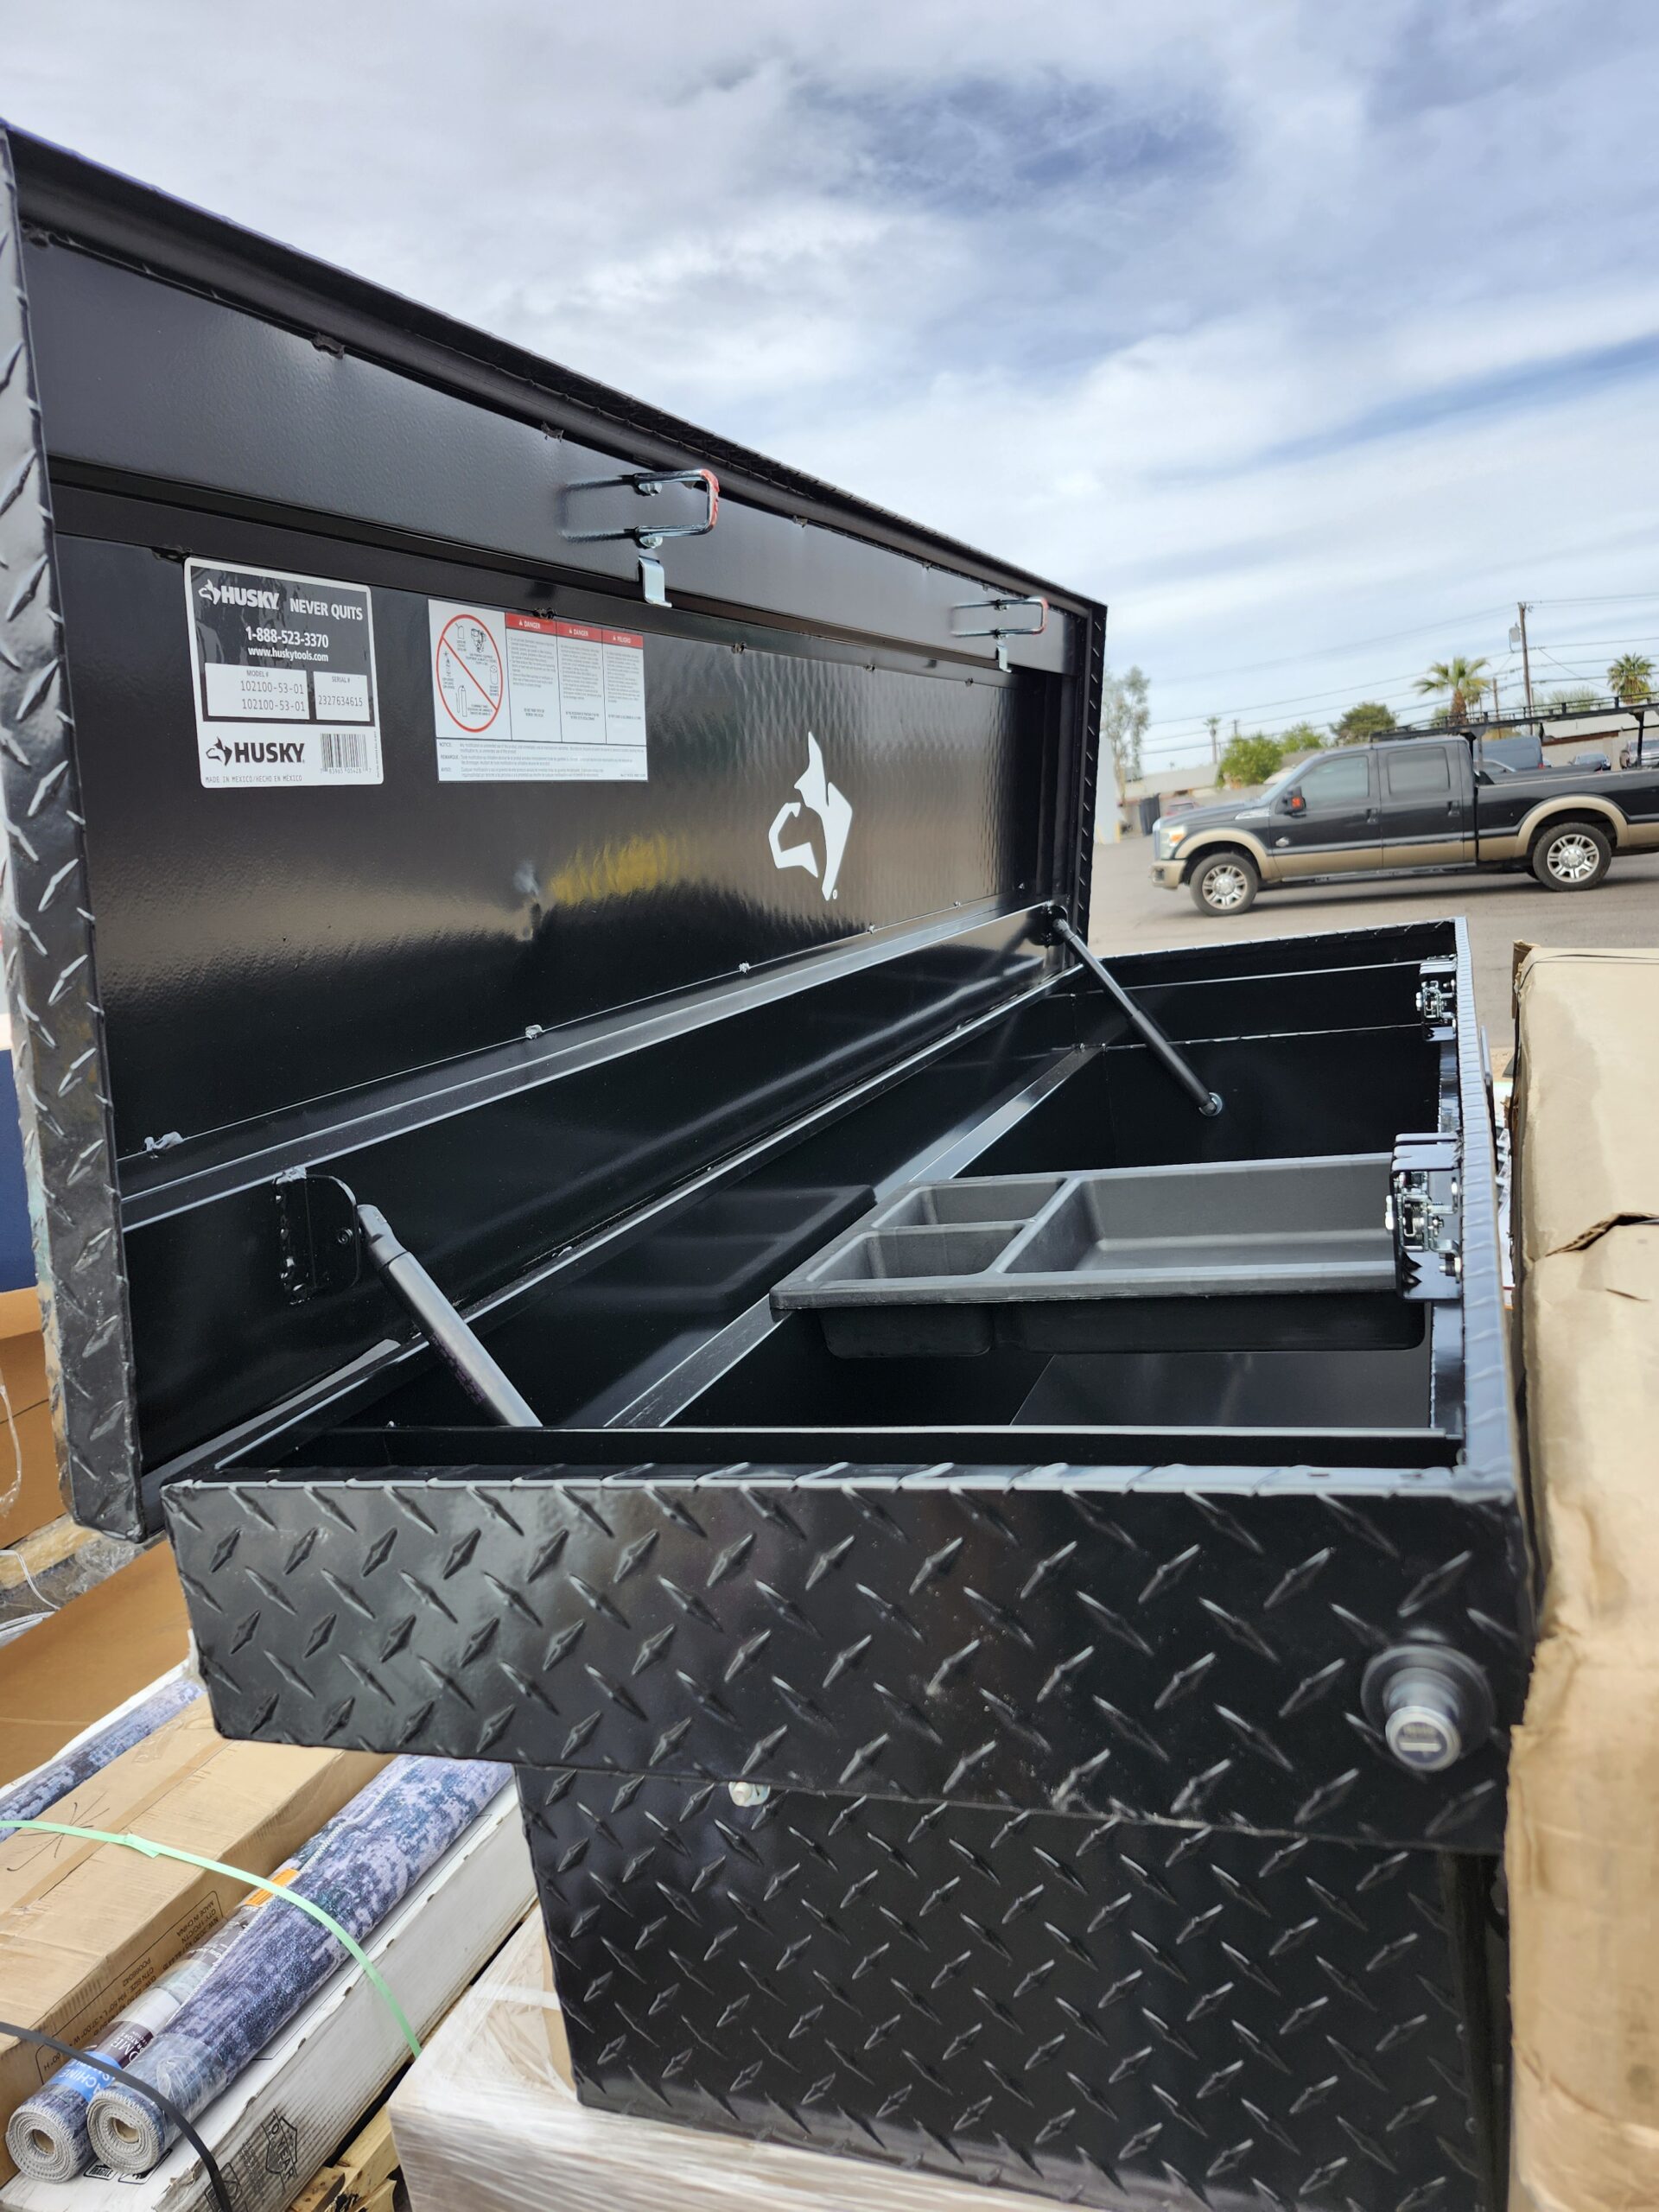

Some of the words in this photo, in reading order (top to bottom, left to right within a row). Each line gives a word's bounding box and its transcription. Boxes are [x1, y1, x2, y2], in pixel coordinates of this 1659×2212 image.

[222, 585, 279, 610] HUSKY
[290, 598, 328, 617] NEVER
[331, 603, 363, 620] QUITS
[524, 620, 541, 630] DANGER
[573, 628, 589, 637] DANGER
[245, 626, 329, 648] 1-888-523-3370
[247, 647, 329, 663] www.huskytools.com
[240, 680, 304, 695] 102100-53-01
[242, 698, 305, 712] 102100-53-01
[318, 695, 363, 707] 2327634615
[234, 742, 305, 763] HUSKY
[200, 1900, 213, 1916] MADE
[176, 1918, 194, 1937] CHINA
[142, 1967, 154, 1980] CTN
[268, 2115, 279, 2133] 10
[278, 2138, 294, 2181] YEAR
